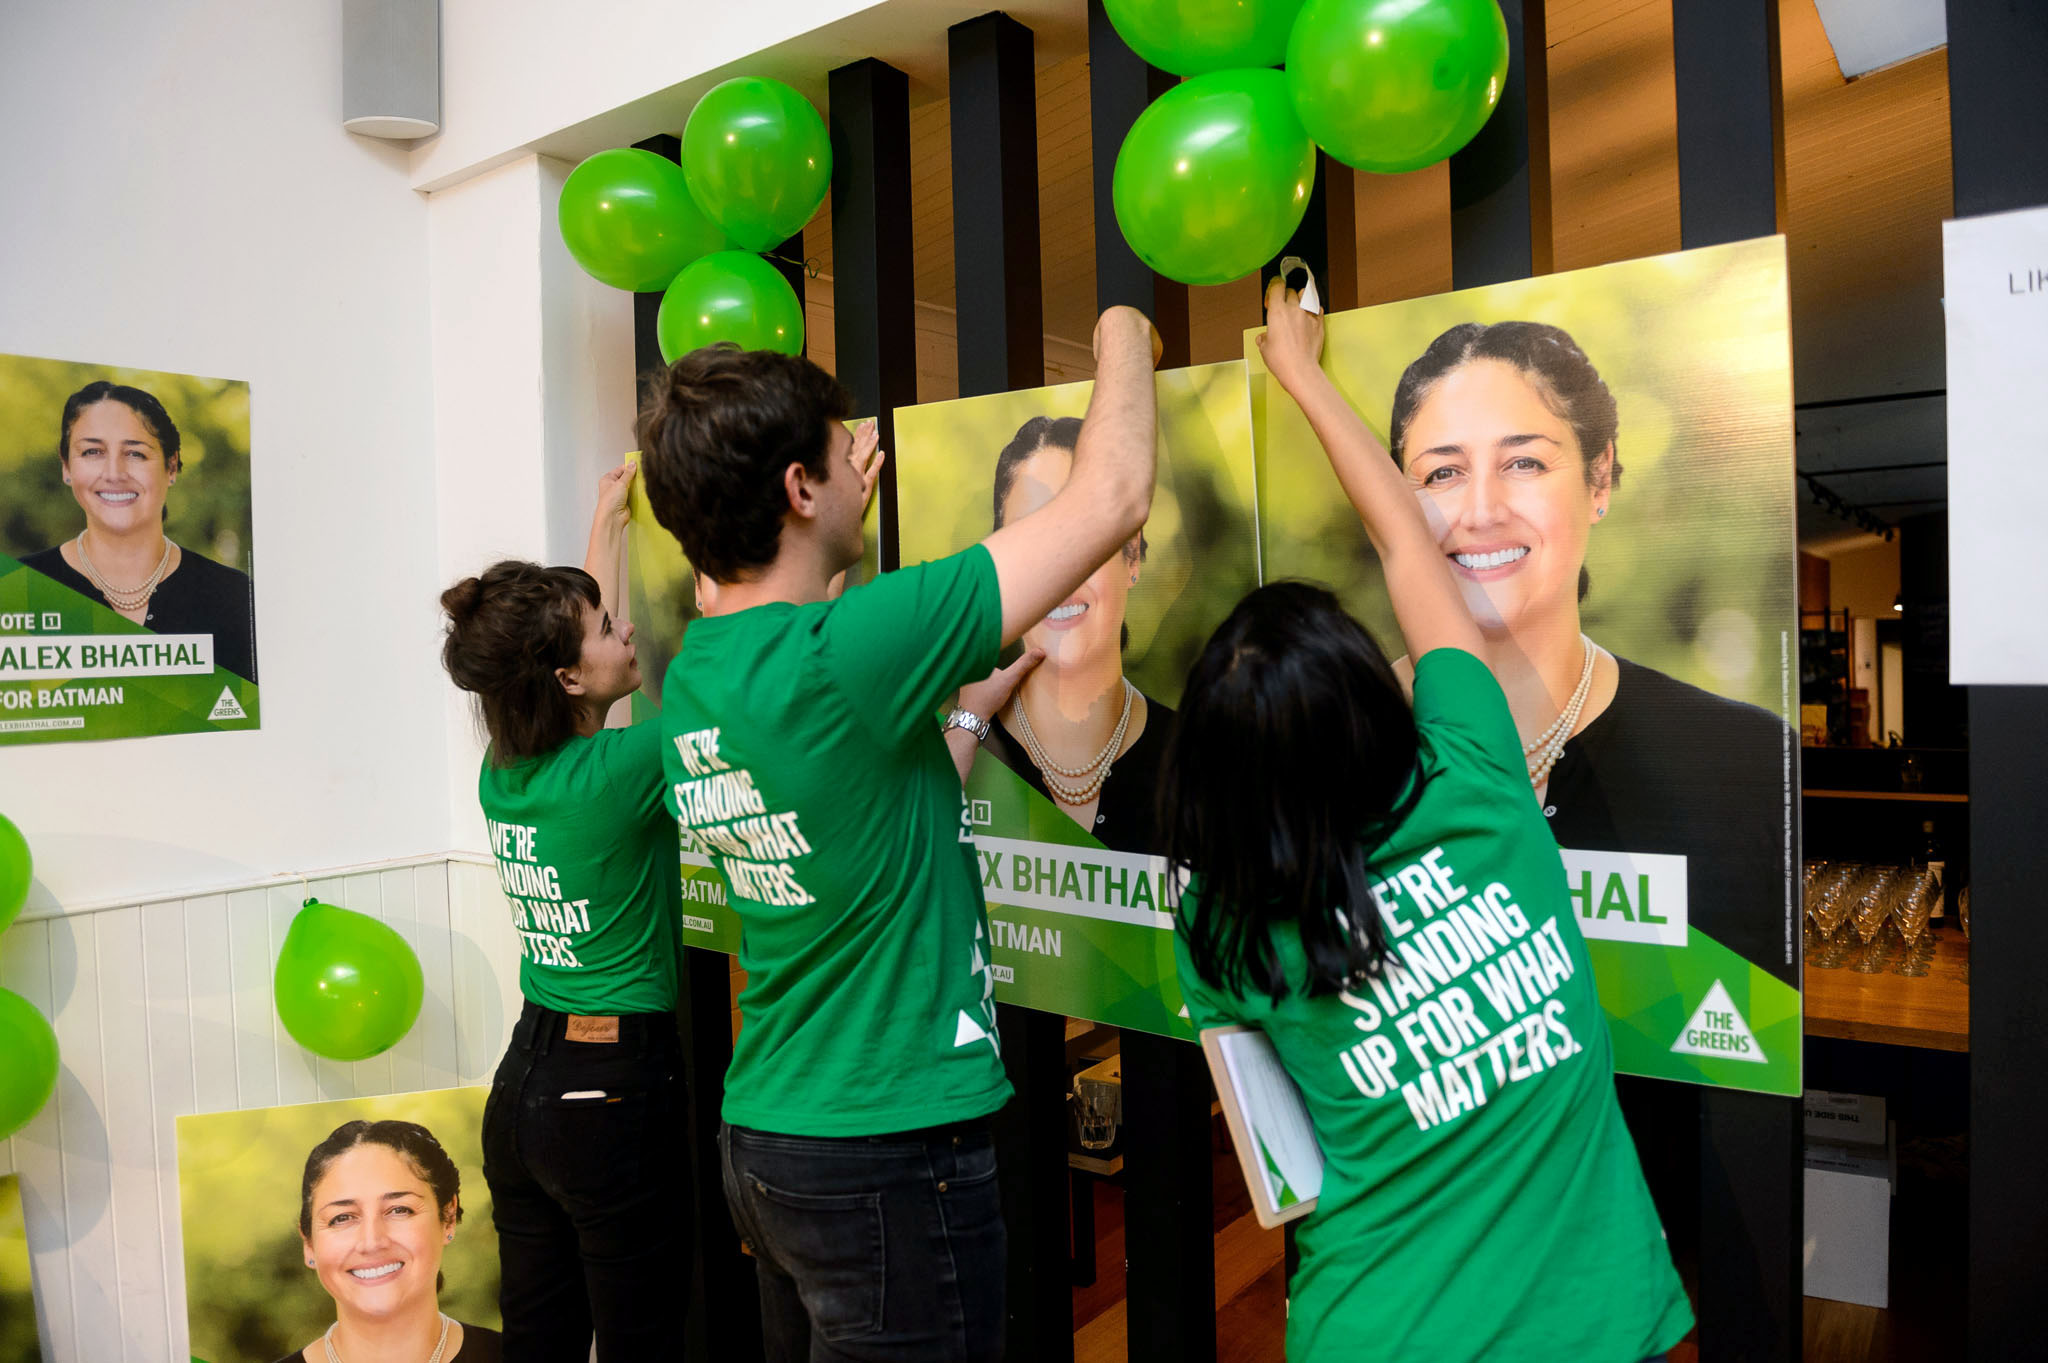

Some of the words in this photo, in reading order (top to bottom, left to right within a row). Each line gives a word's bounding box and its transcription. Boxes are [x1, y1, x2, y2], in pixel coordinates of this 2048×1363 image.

[0, 613, 35, 630] OTE
[0, 645, 72, 670] ALEX
[81, 643, 206, 669] BHATHAL
[0, 690, 33, 709] OR
[38, 687, 124, 709] BATMAN
[214, 707, 241, 717] GREENS
[220, 698, 234, 707] THE
[674, 769, 767, 827] STANDING
[488, 818, 538, 863] WE'RE
[732, 810, 813, 861] WHAT
[681, 878, 728, 906] BATM
[1012, 854, 1177, 913] BHATHAL
[1338, 846, 1469, 948] E'RE
[527, 899, 591, 935] WHAT
[683, 917, 713, 930] L.COM.AU
[1339, 1034, 1399, 1099] UP
[1395, 986, 1491, 1070] FOR
[1471, 915, 1575, 1023] WHAT
[1704, 1010, 1734, 1031] THE
[1686, 1029, 1750, 1053] GREENS
[1400, 999, 1583, 1132] MATTERS.
